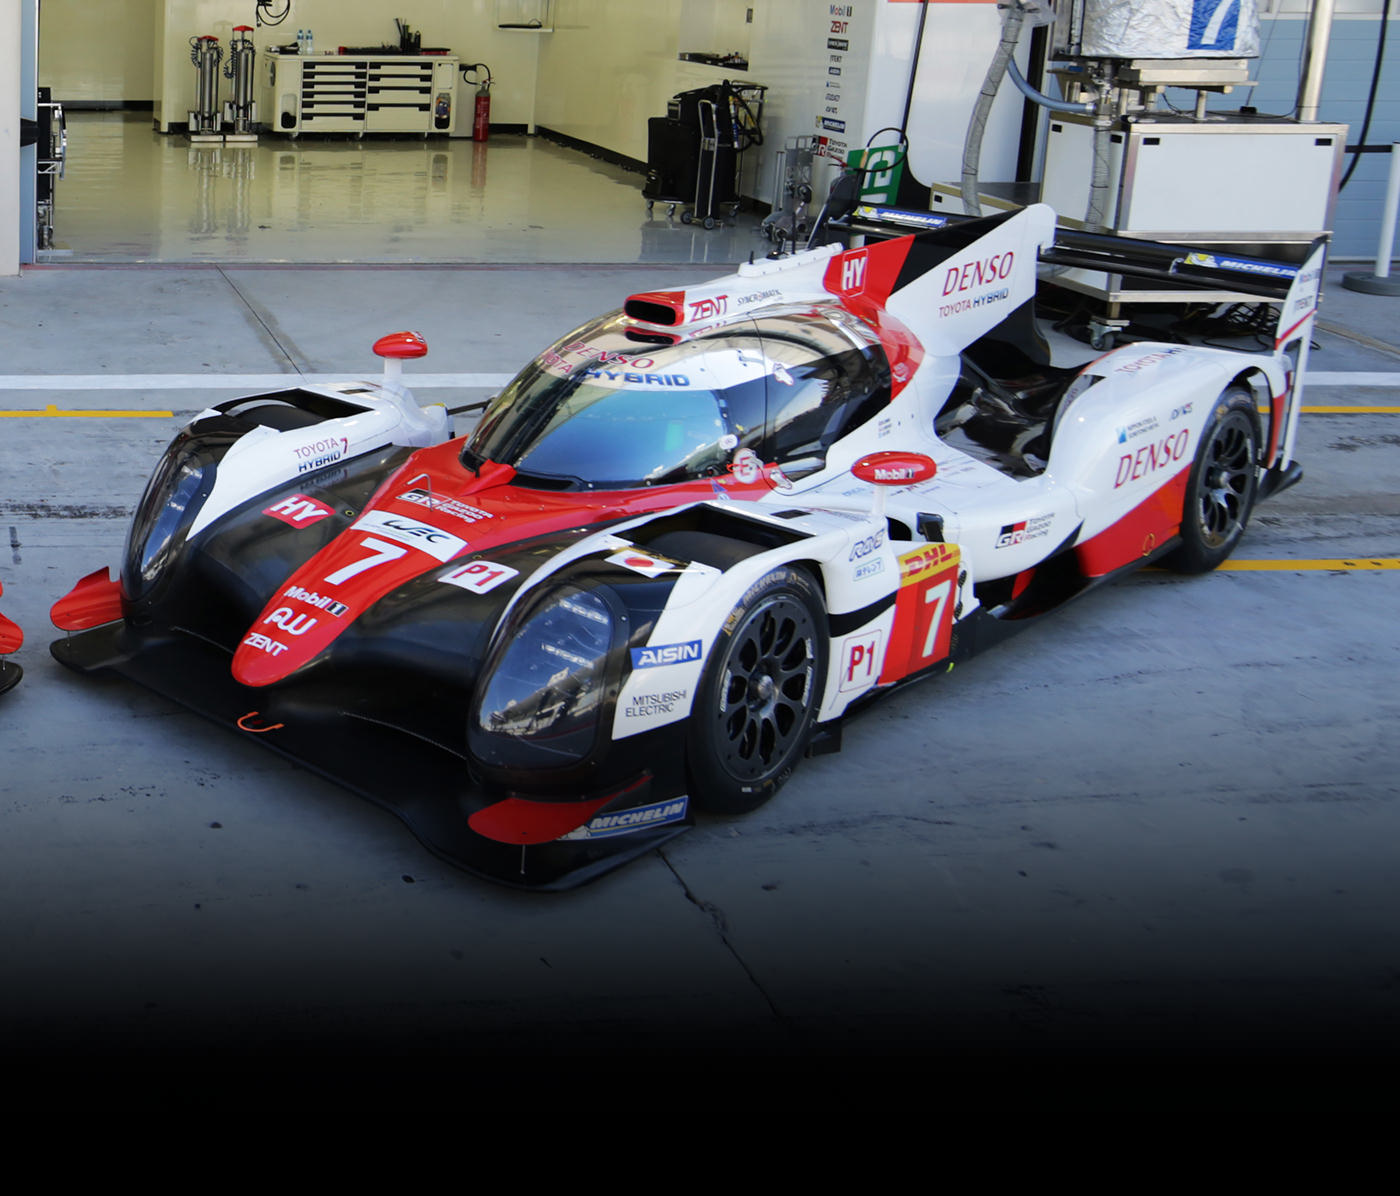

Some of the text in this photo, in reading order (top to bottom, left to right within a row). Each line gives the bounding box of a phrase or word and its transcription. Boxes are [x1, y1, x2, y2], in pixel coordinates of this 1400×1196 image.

[830, 20, 848, 34] ZENT
[880, 211, 943, 226] MICHELIN
[842, 256, 867, 291] HY
[942, 251, 1015, 296] DENSO
[1219, 260, 1298, 277] MICHELIN
[688, 294, 729, 323] ZENT
[938, 288, 1009, 318] TOYOTA HYBRID
[562, 342, 655, 369] DENSO
[581, 368, 690, 387] HYBRID
[294, 437, 348, 459] TOYOTA 7
[1114, 428, 1189, 489] DENSO
[298, 451, 341, 473] HYBRID
[874, 468, 906, 480] Mobil
[272, 496, 329, 522] HY
[400, 492, 441, 509] GR
[382, 519, 450, 544] WEC
[999, 531, 1024, 547] GR
[323, 537, 408, 585] 7
[904, 544, 953, 577] DHL
[450, 564, 506, 588] P1
[284, 586, 331, 609] Mobil
[922, 579, 951, 659] 7
[243, 631, 289, 657] ZENT
[638, 643, 700, 666] AISIN
[848, 640, 876, 682] P1
[625, 702, 675, 718] ELECTRIC
[632, 690, 687, 706] MITSUBISHI
[590, 802, 685, 830] MICHELIN
